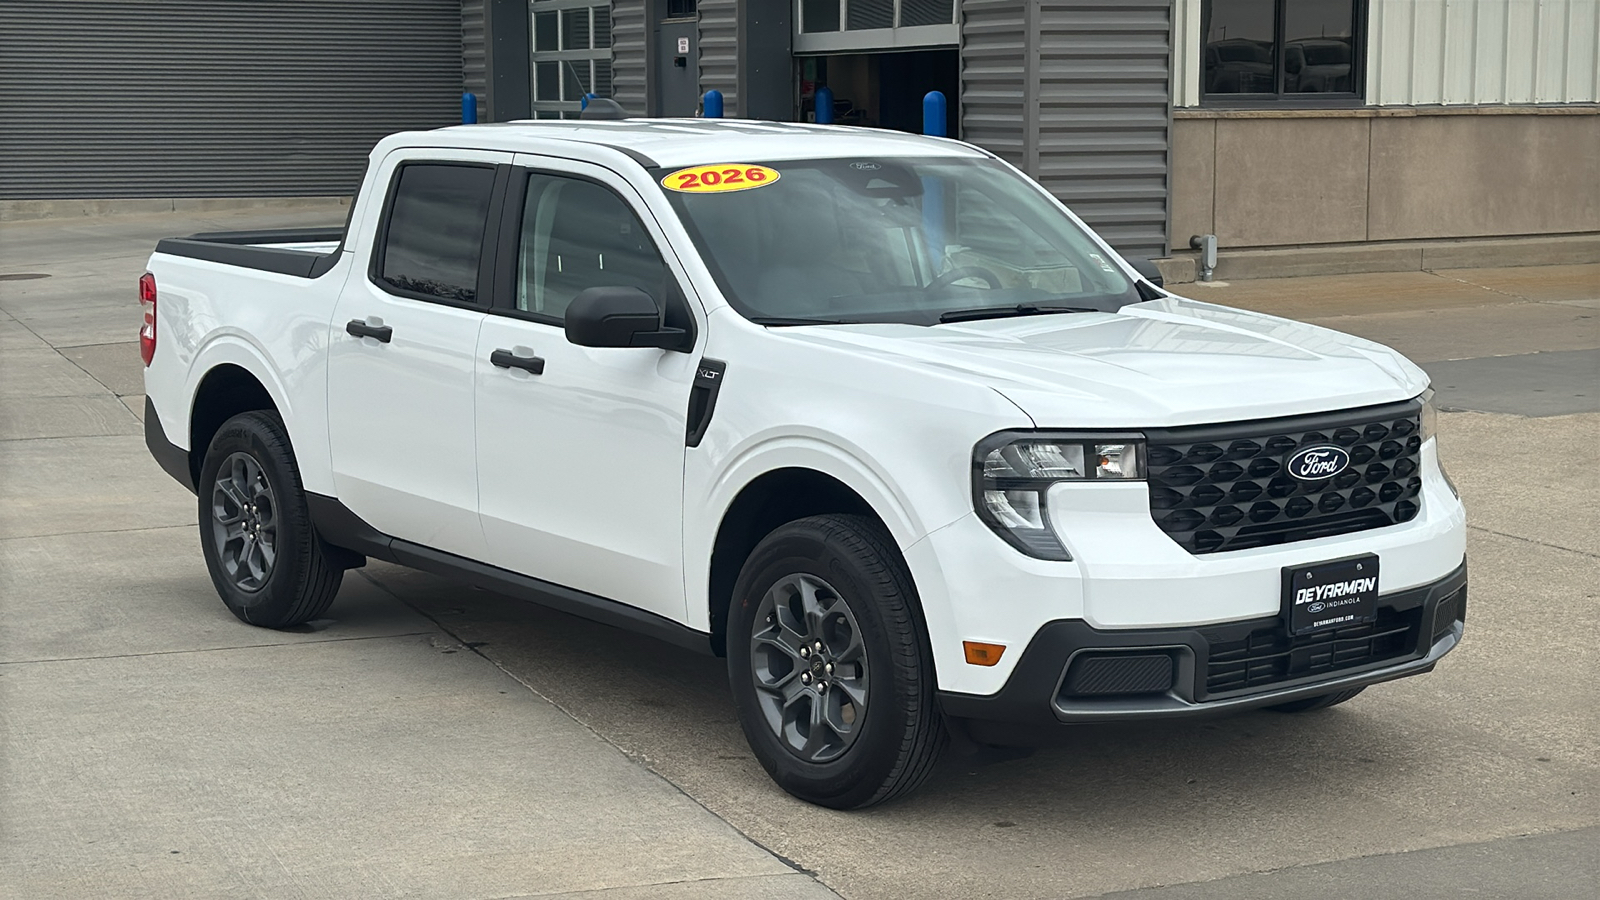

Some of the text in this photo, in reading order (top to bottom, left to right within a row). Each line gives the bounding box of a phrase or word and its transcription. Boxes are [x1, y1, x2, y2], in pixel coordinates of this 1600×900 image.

[678, 168, 767, 189] 2026
[697, 369, 719, 379] XLT
[1301, 451, 1339, 476] Ford
[1295, 577, 1376, 605] DEYARMAN
[1326, 597, 1360, 608] INDIANOLA
